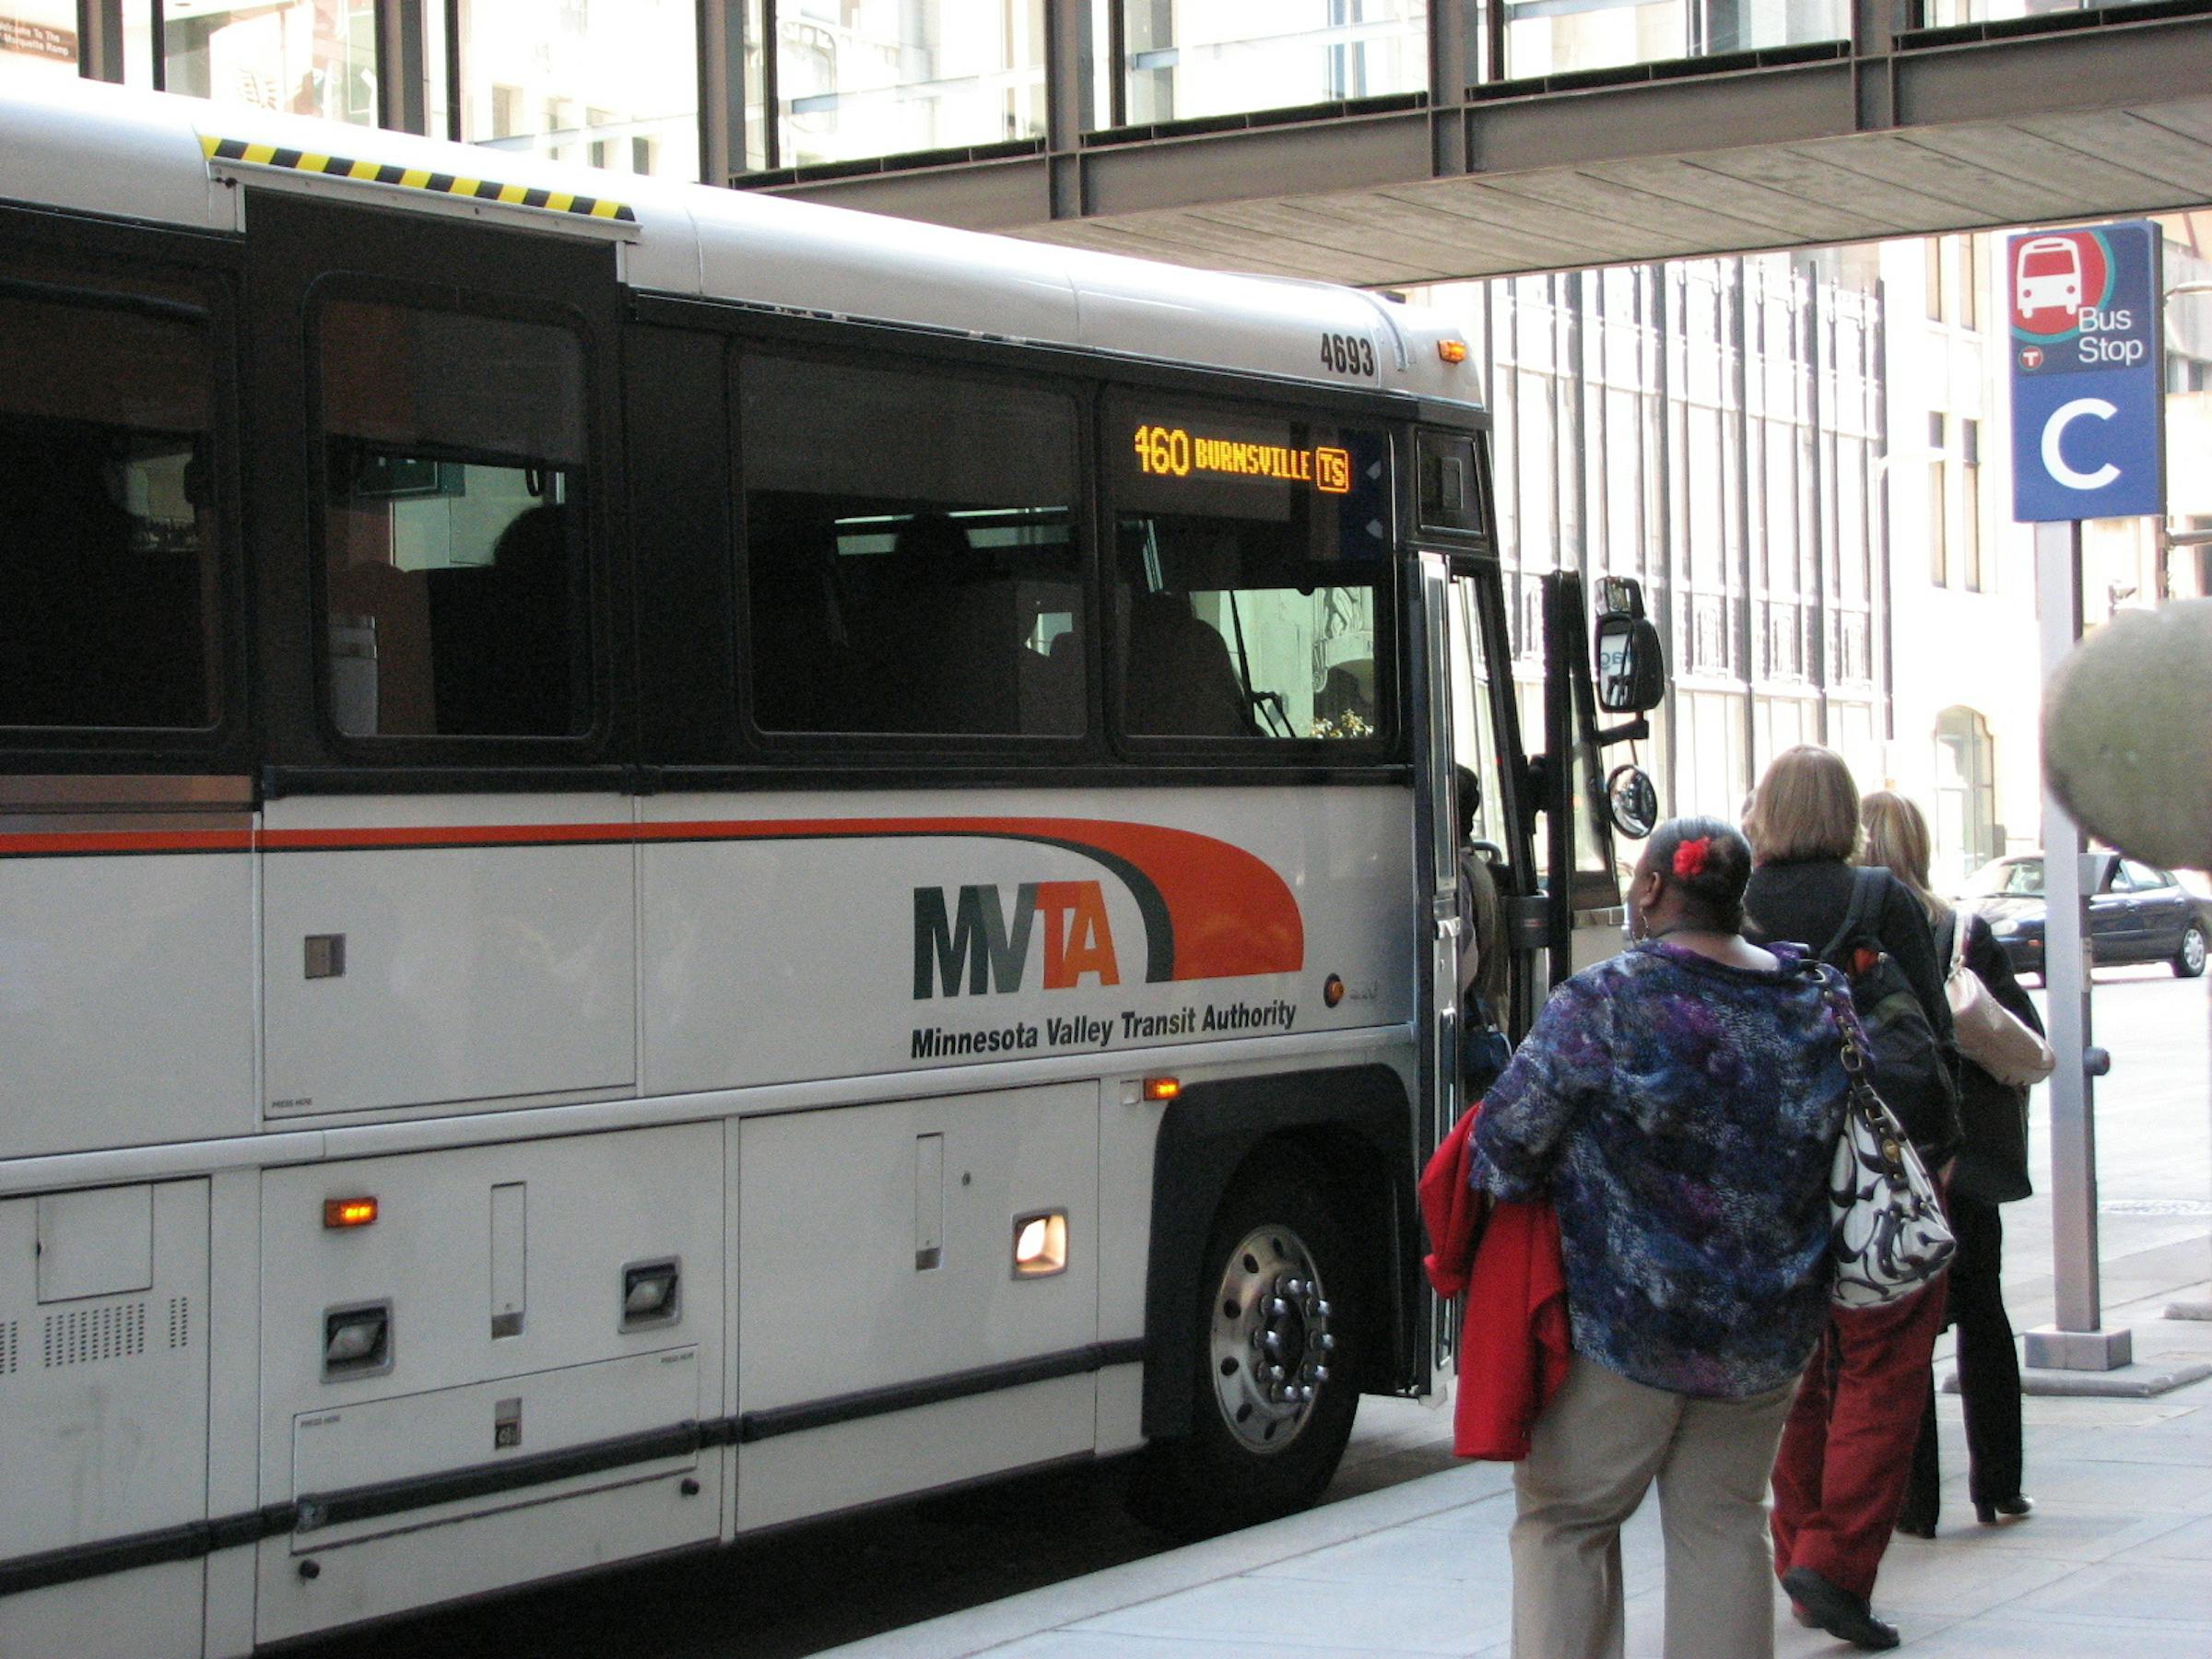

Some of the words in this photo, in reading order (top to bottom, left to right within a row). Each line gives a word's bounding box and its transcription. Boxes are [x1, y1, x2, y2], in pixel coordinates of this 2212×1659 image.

[0, 23, 31, 39] elcome
[44, 29, 60, 43] The
[2078, 306, 2131, 333] Bus
[1321, 333, 1374, 377] 4693
[2078, 335, 2143, 366] Stop
[1135, 425, 1190, 477] 460
[1194, 437, 1311, 480] BURNSVILLE
[1319, 453, 1346, 488] TS
[2041, 397, 2121, 490] C
[913, 880, 1120, 1000] MVTA
[911, 1023, 1038, 1059] Minnesota
[1047, 1015, 1113, 1046] Valley
[1122, 1007, 1195, 1040] Transit
[1201, 999, 1297, 1030] Authority
